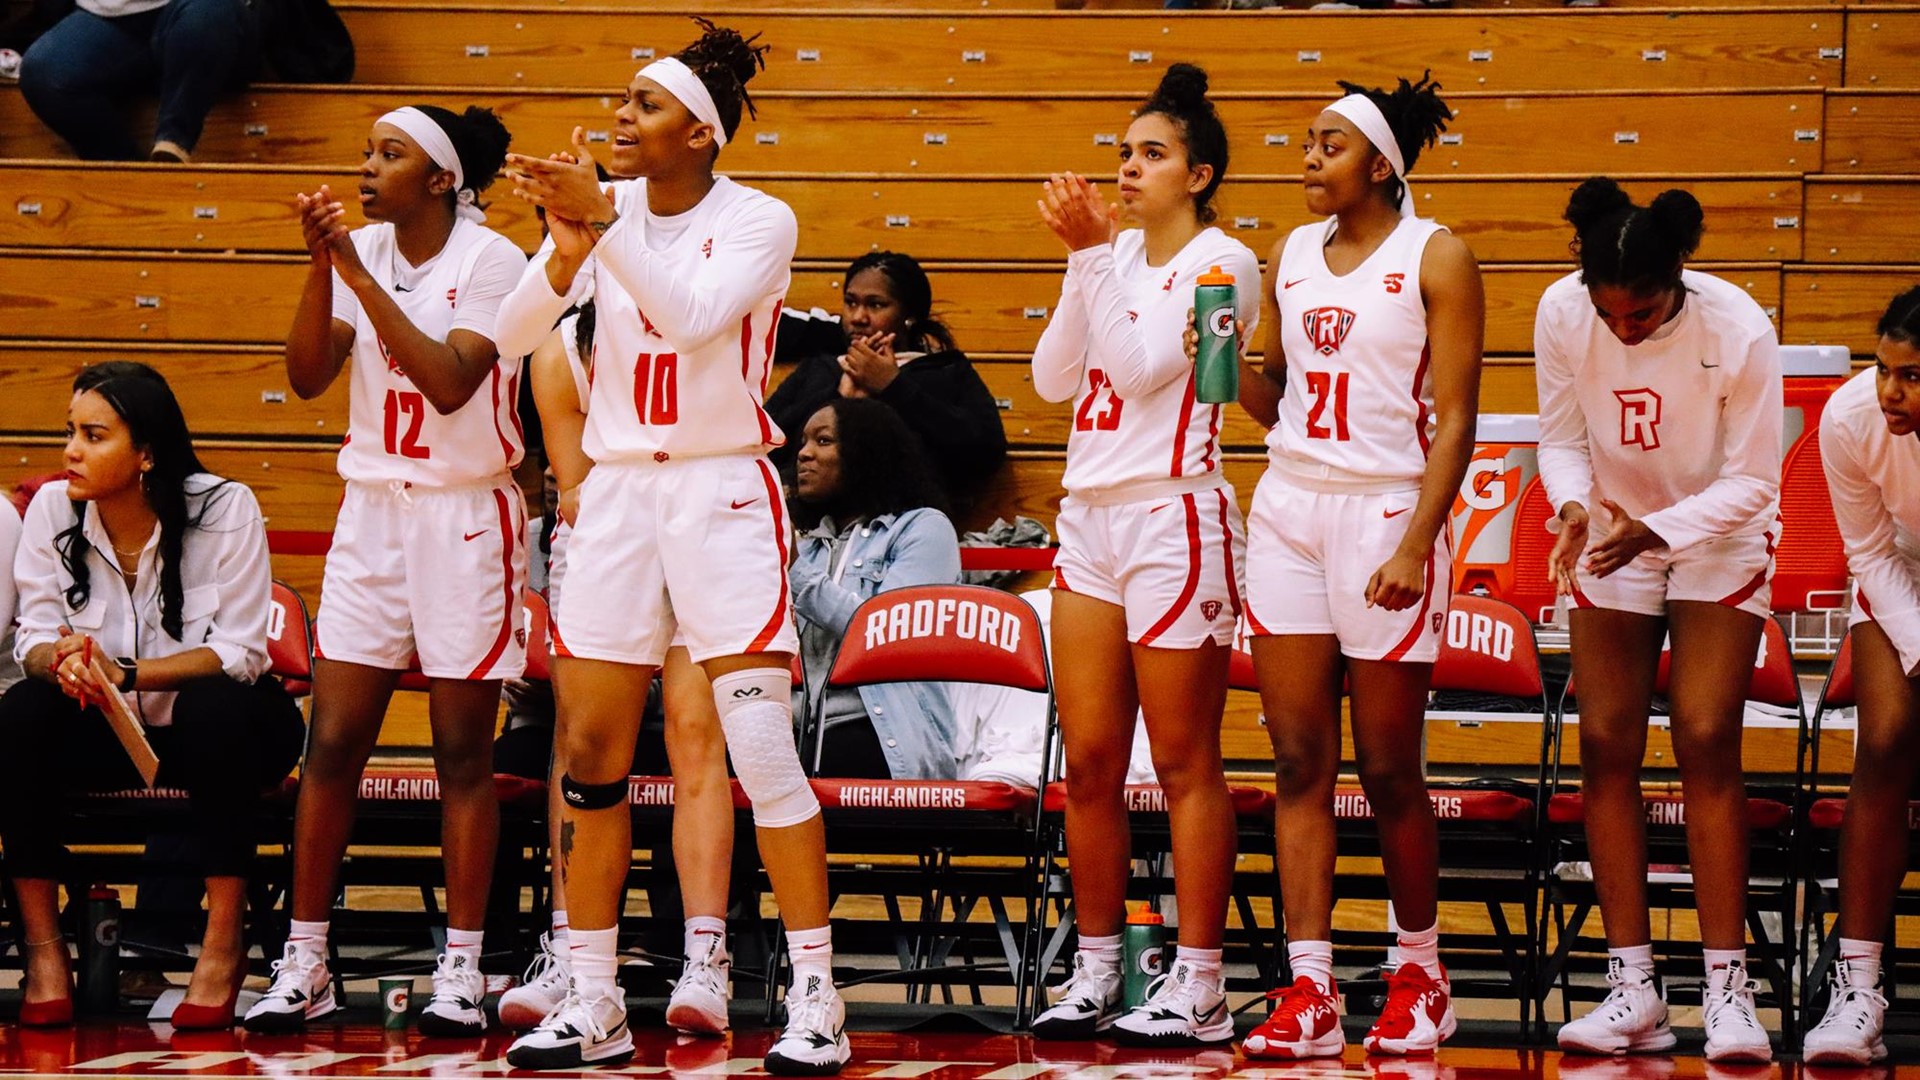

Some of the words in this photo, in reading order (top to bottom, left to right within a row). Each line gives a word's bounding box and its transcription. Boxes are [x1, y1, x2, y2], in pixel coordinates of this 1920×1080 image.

[1209, 307, 1235, 338] G
[1317, 309, 1339, 344] R
[633, 352, 678, 425] 10
[1076, 368, 1124, 432] 23
[1306, 371, 1350, 441] 21
[383, 389, 430, 459] 12
[1613, 388, 1662, 451] R
[1459, 457, 1506, 511] G
[865, 599, 1021, 654] RADFORD
[840, 786, 966, 808] HIGHLANDERS
[95, 919, 119, 947] G
[1139, 947, 1163, 976] G
[387, 987, 409, 1013] G
